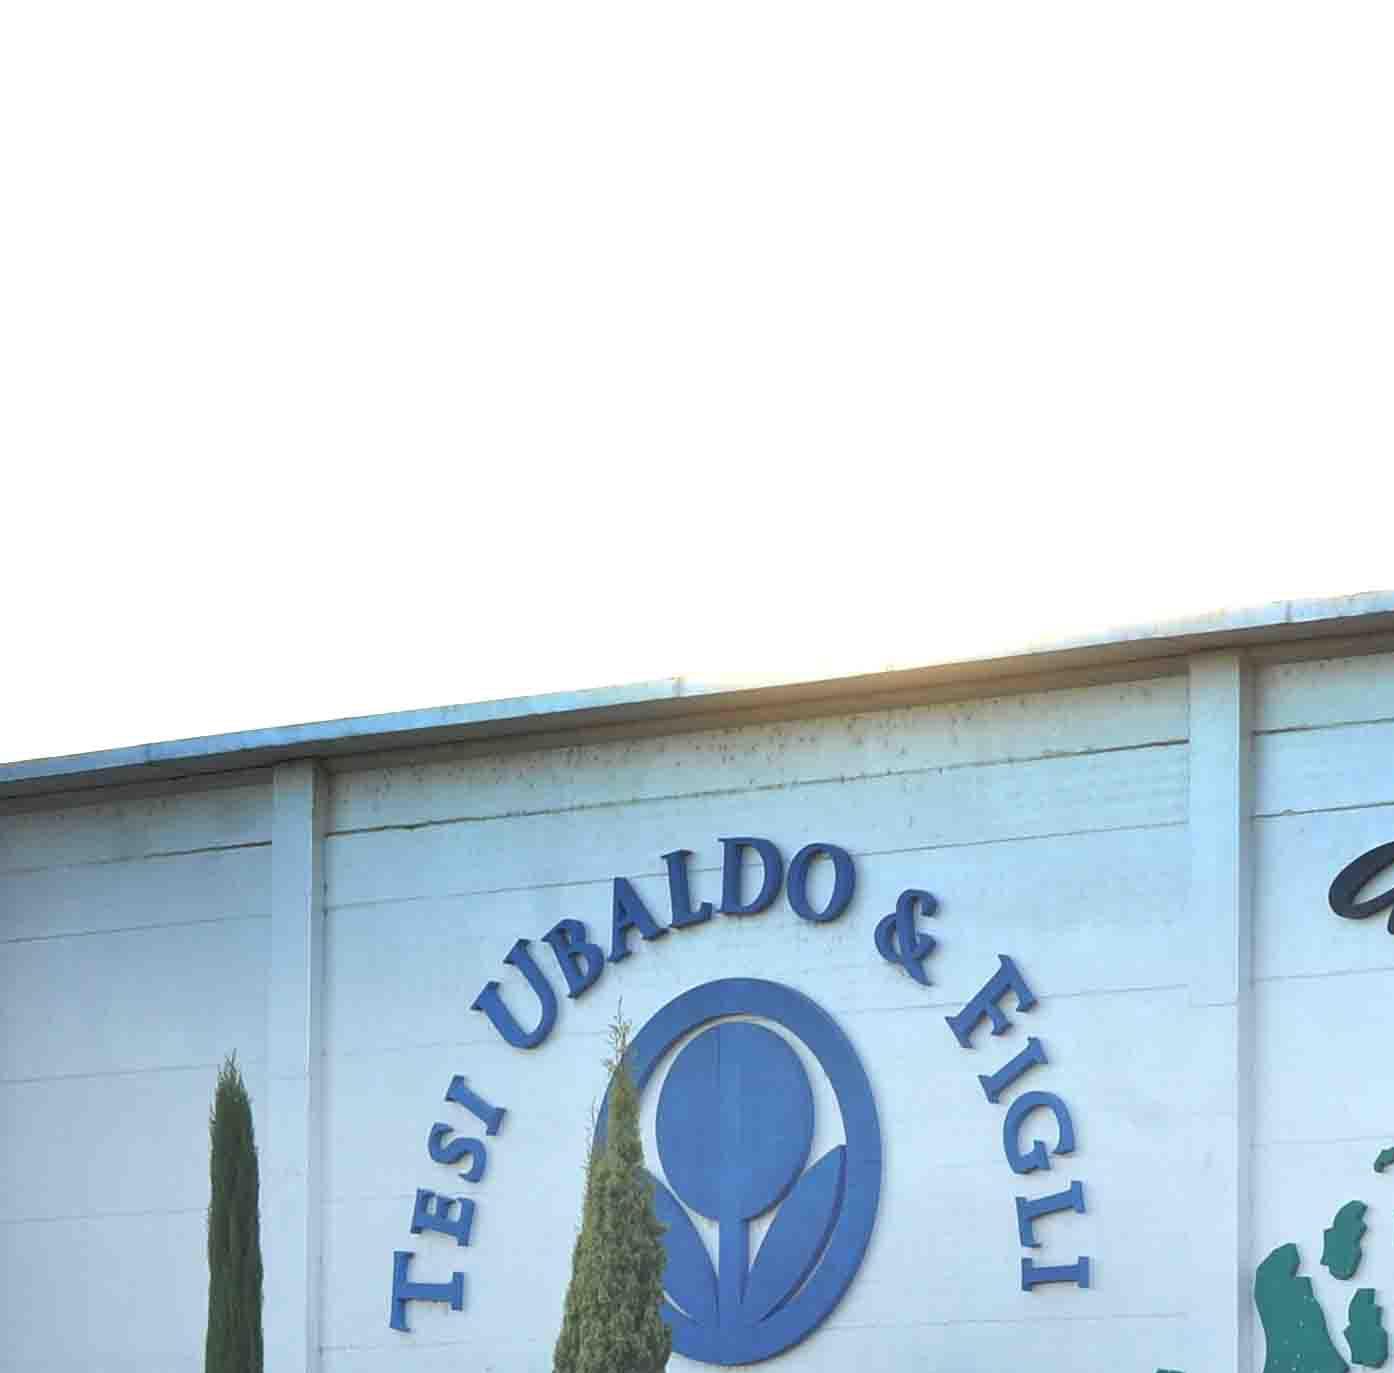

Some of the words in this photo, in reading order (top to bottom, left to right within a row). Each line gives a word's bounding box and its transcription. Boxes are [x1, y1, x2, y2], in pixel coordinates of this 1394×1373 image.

[389, 1074, 507, 1333] TESI
[470, 836, 857, 1050] UBALDO
[873, 888, 942, 987] &
[944, 953, 1091, 1293] FIGLI
